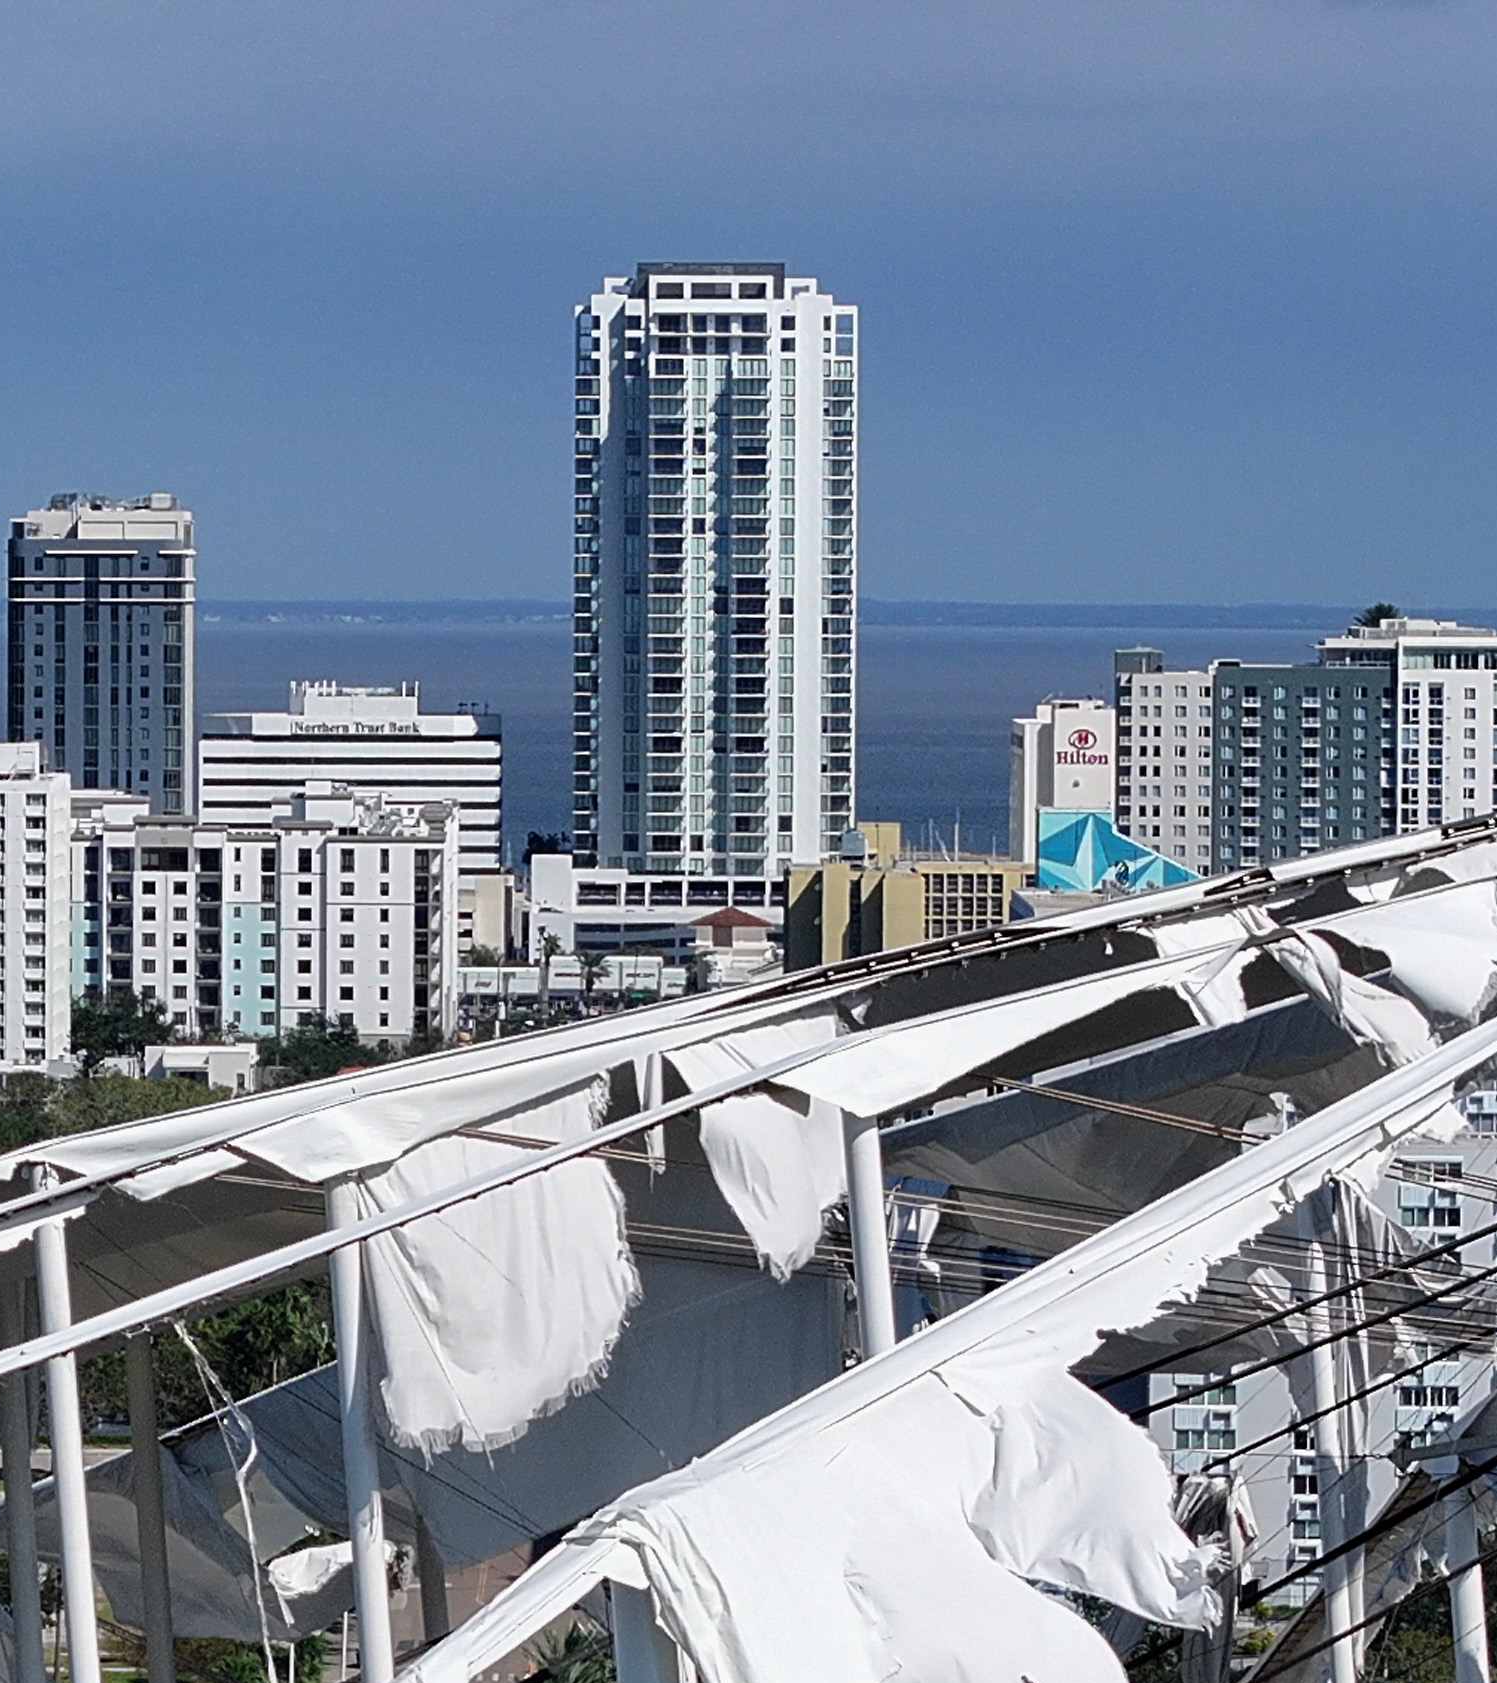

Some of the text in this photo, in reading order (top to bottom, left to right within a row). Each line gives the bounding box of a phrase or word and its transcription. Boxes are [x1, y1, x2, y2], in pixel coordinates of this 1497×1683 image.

[353, 721, 385, 734] Trust
[389, 721, 420, 733] Bank
[1056, 750, 1108, 765] Hilton
